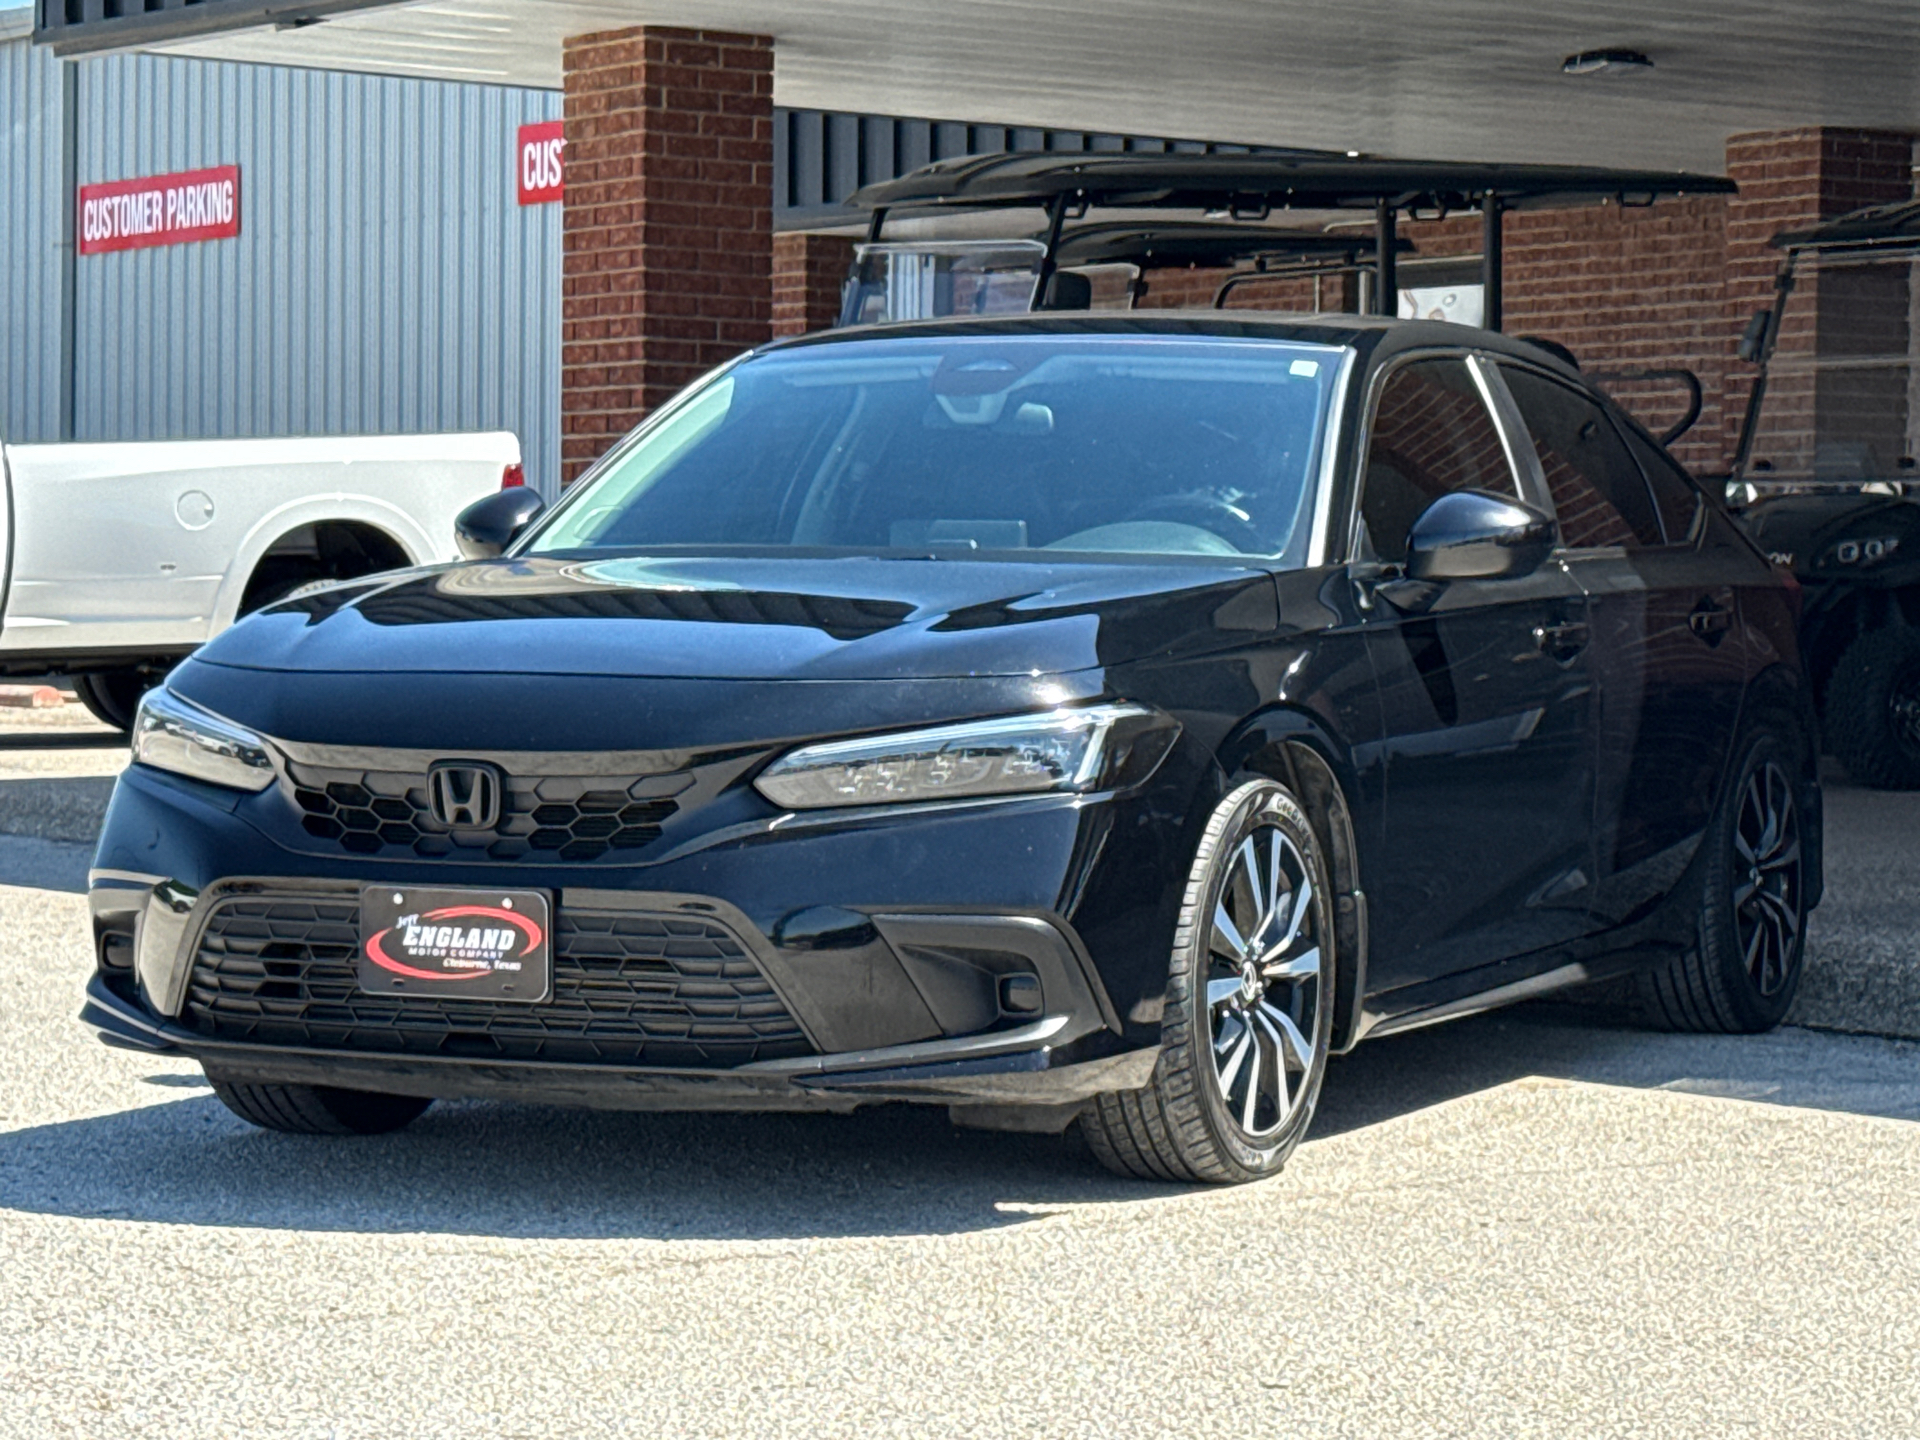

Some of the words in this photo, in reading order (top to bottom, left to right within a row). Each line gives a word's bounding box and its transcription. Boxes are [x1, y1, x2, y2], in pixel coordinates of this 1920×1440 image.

[84, 190, 163, 242] CUSTOMER
[166, 180, 233, 231] PARKING
[402, 926, 516, 950] ENGLAND
[408, 947, 447, 957] MOTOR
[450, 949, 504, 959] COMPANY
[494, 960, 522, 971] Texas
